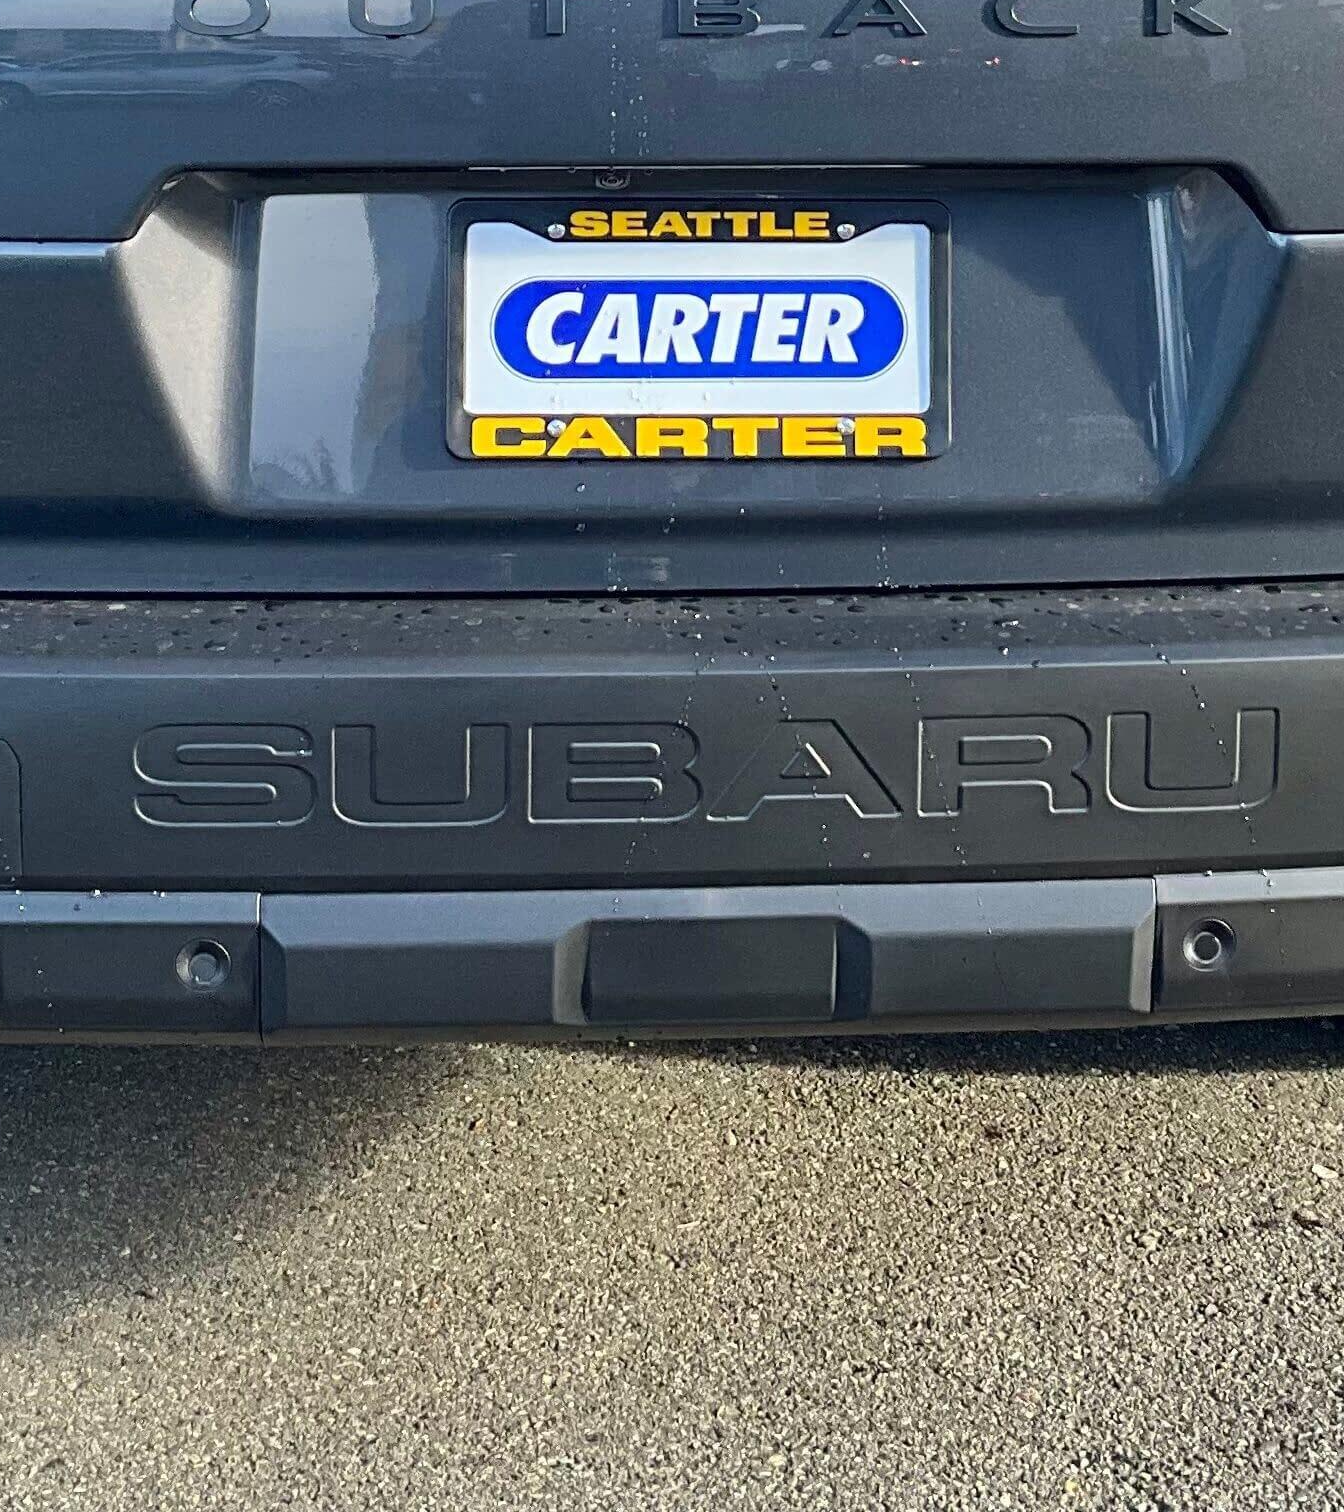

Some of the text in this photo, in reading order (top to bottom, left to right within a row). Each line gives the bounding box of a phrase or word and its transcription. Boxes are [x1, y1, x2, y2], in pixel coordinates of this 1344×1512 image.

[570, 211, 831, 238] SEATTLE
[525, 292, 865, 365] CARTER
[471, 416, 928, 457] CARTER
[132, 706, 1280, 829] SUBARU
